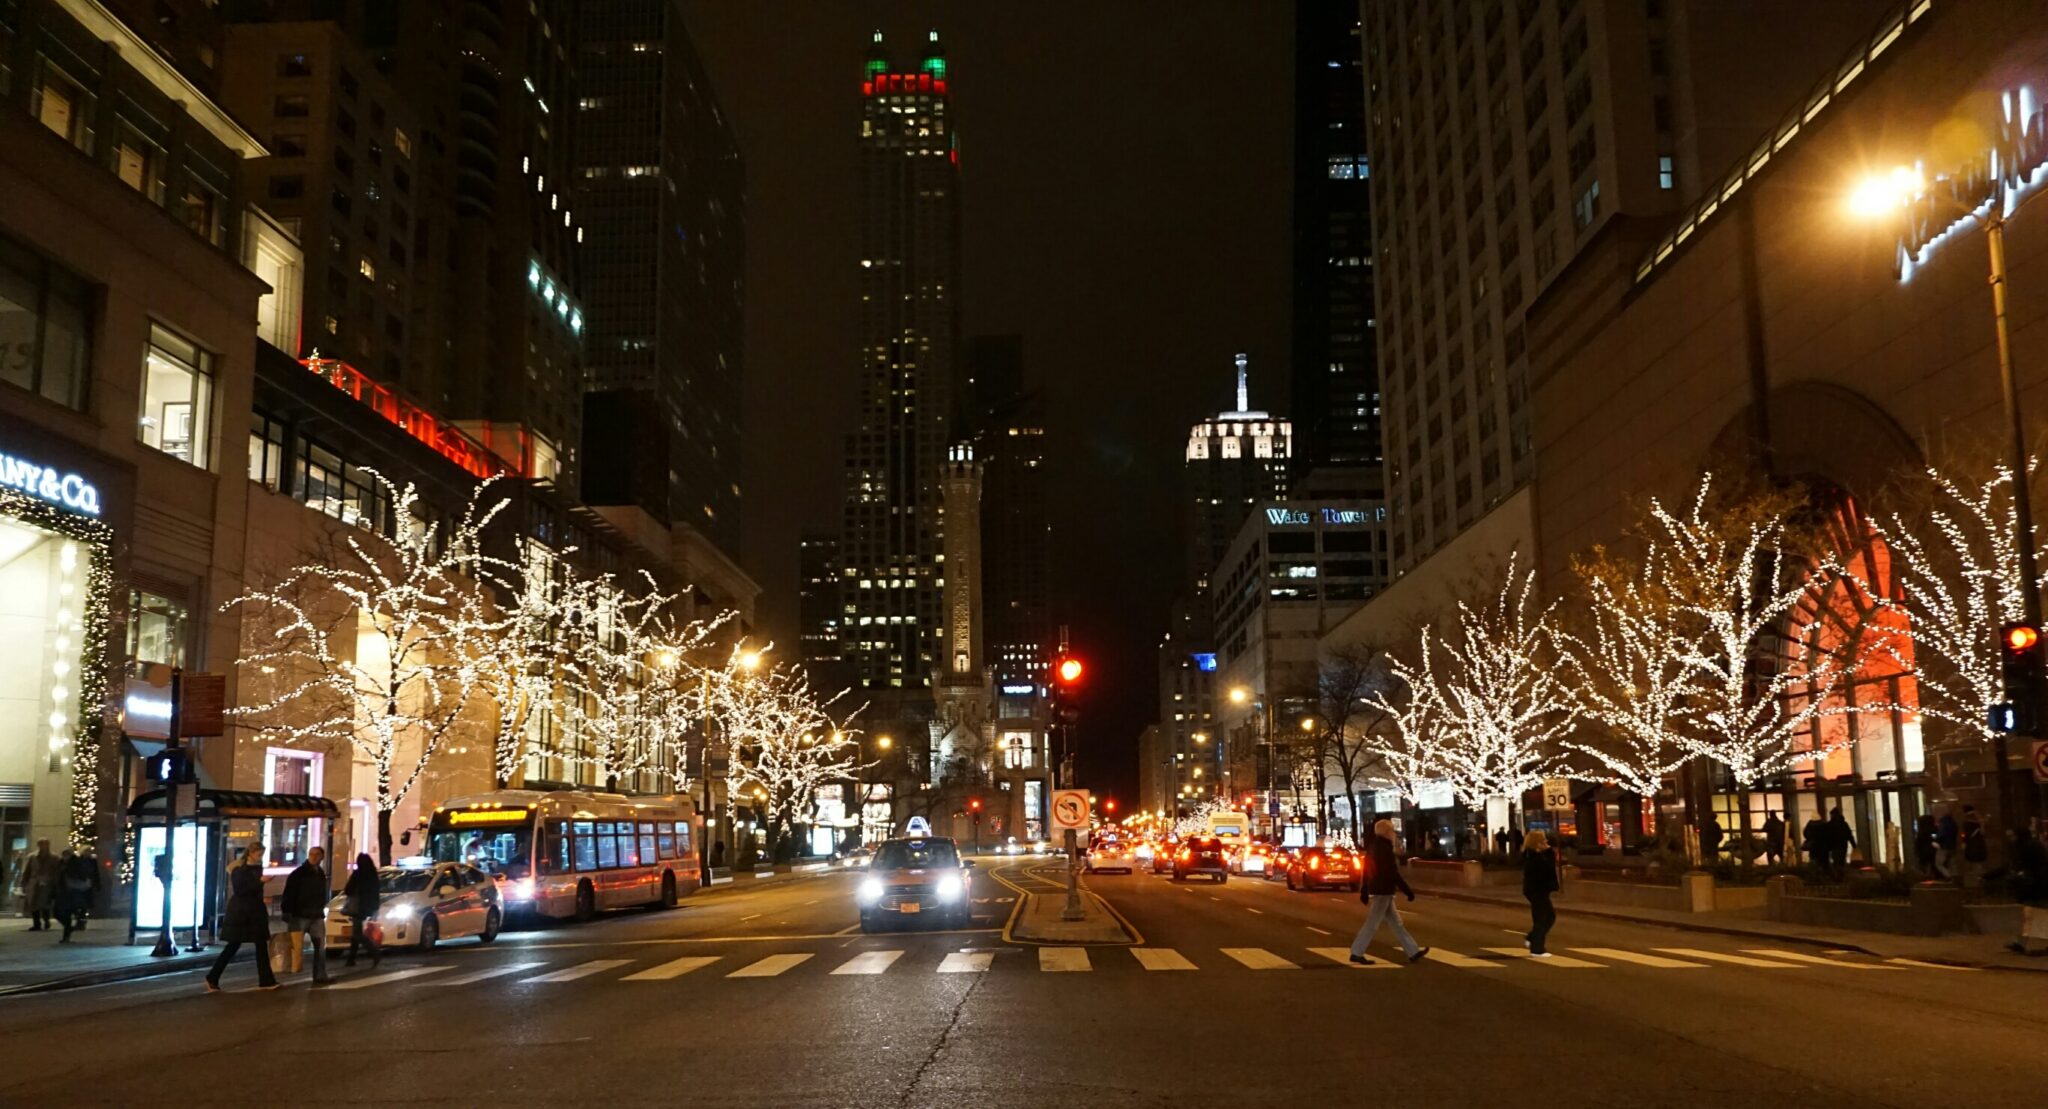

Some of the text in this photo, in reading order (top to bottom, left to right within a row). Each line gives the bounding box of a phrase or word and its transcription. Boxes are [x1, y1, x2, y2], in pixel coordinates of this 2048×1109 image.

[1266, 508, 1316, 525] Wate
[1321, 508, 1369, 524] Tower
[1547, 794, 1567, 806] 30
